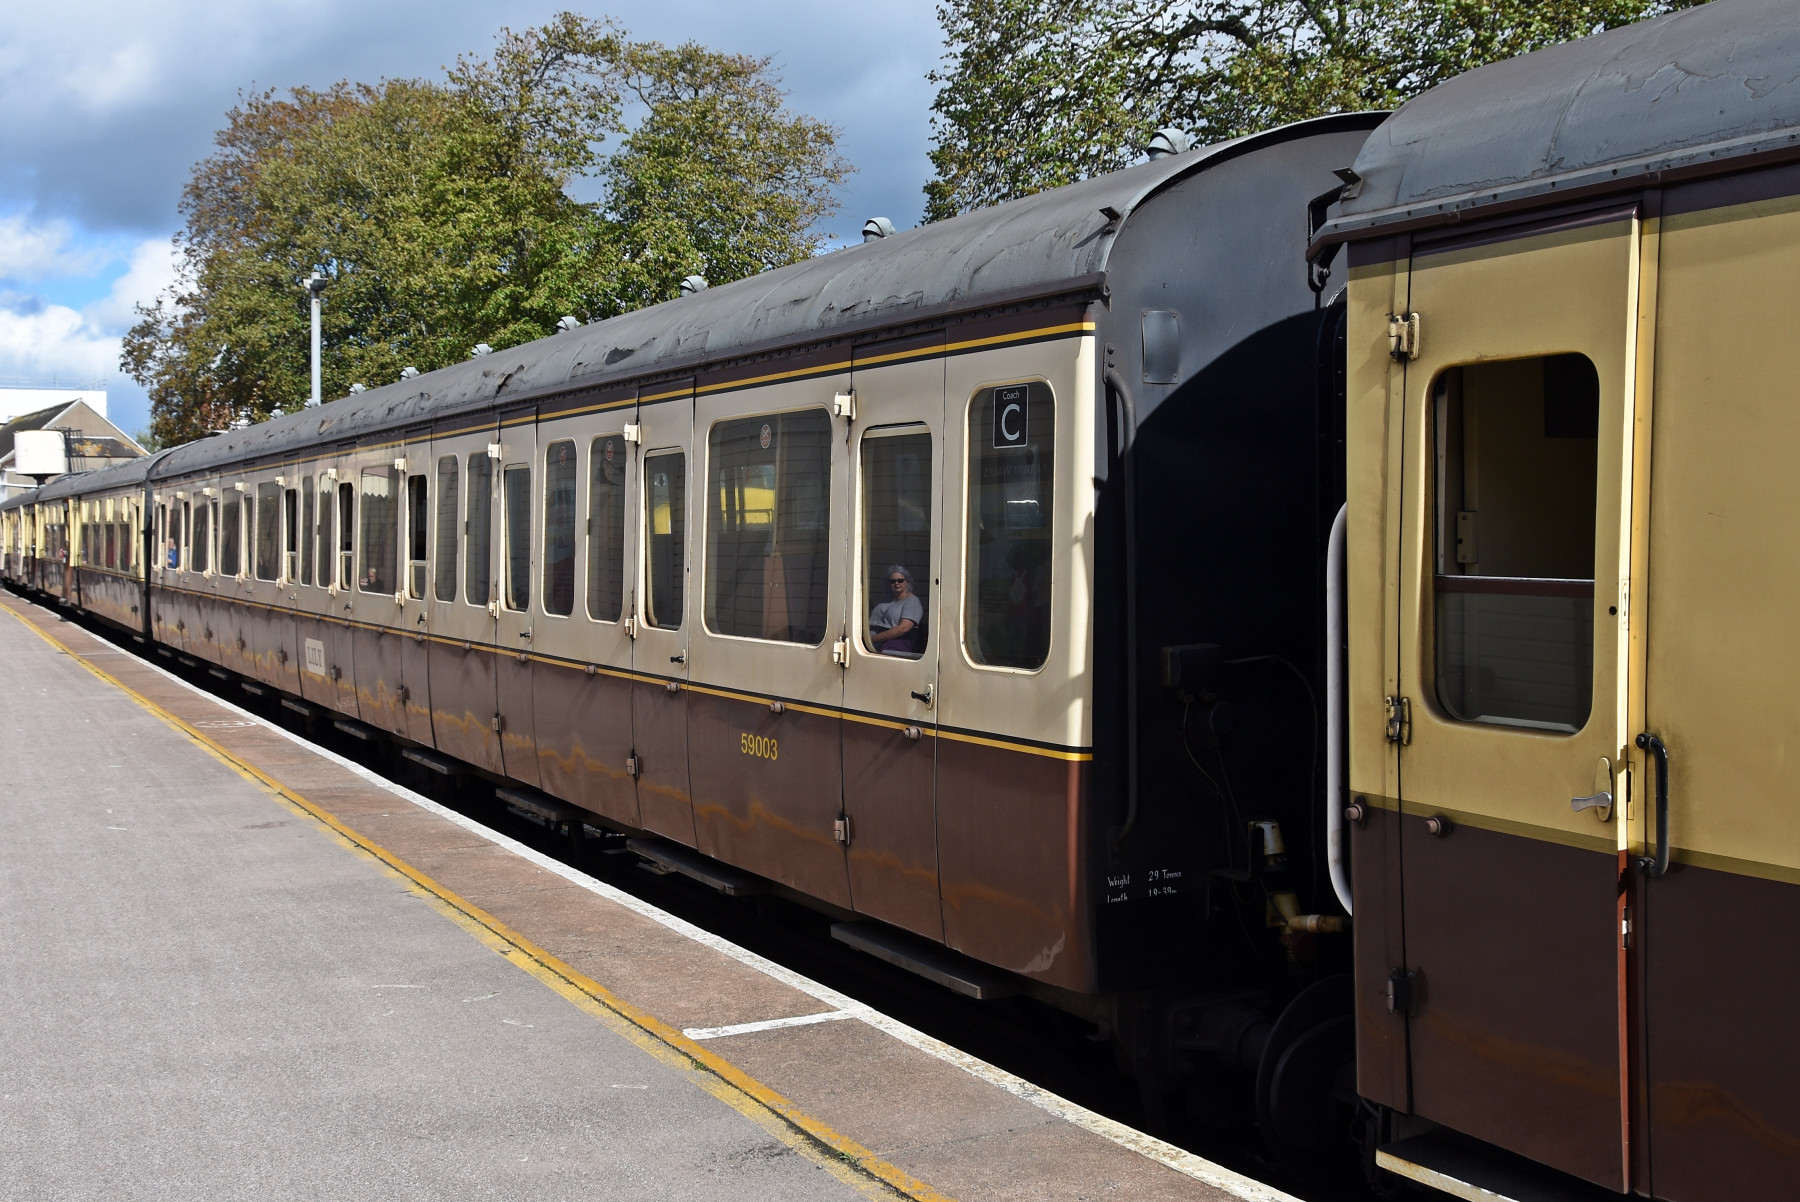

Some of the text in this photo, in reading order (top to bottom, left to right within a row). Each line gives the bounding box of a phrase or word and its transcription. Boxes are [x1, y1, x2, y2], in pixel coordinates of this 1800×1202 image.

[1002, 390, 1020, 400] Coach
[1001, 403, 1020, 441] C
[741, 732, 778, 761] 59003
[1107, 874, 1131, 889] Weight
[1148, 870, 1159, 882] 29
